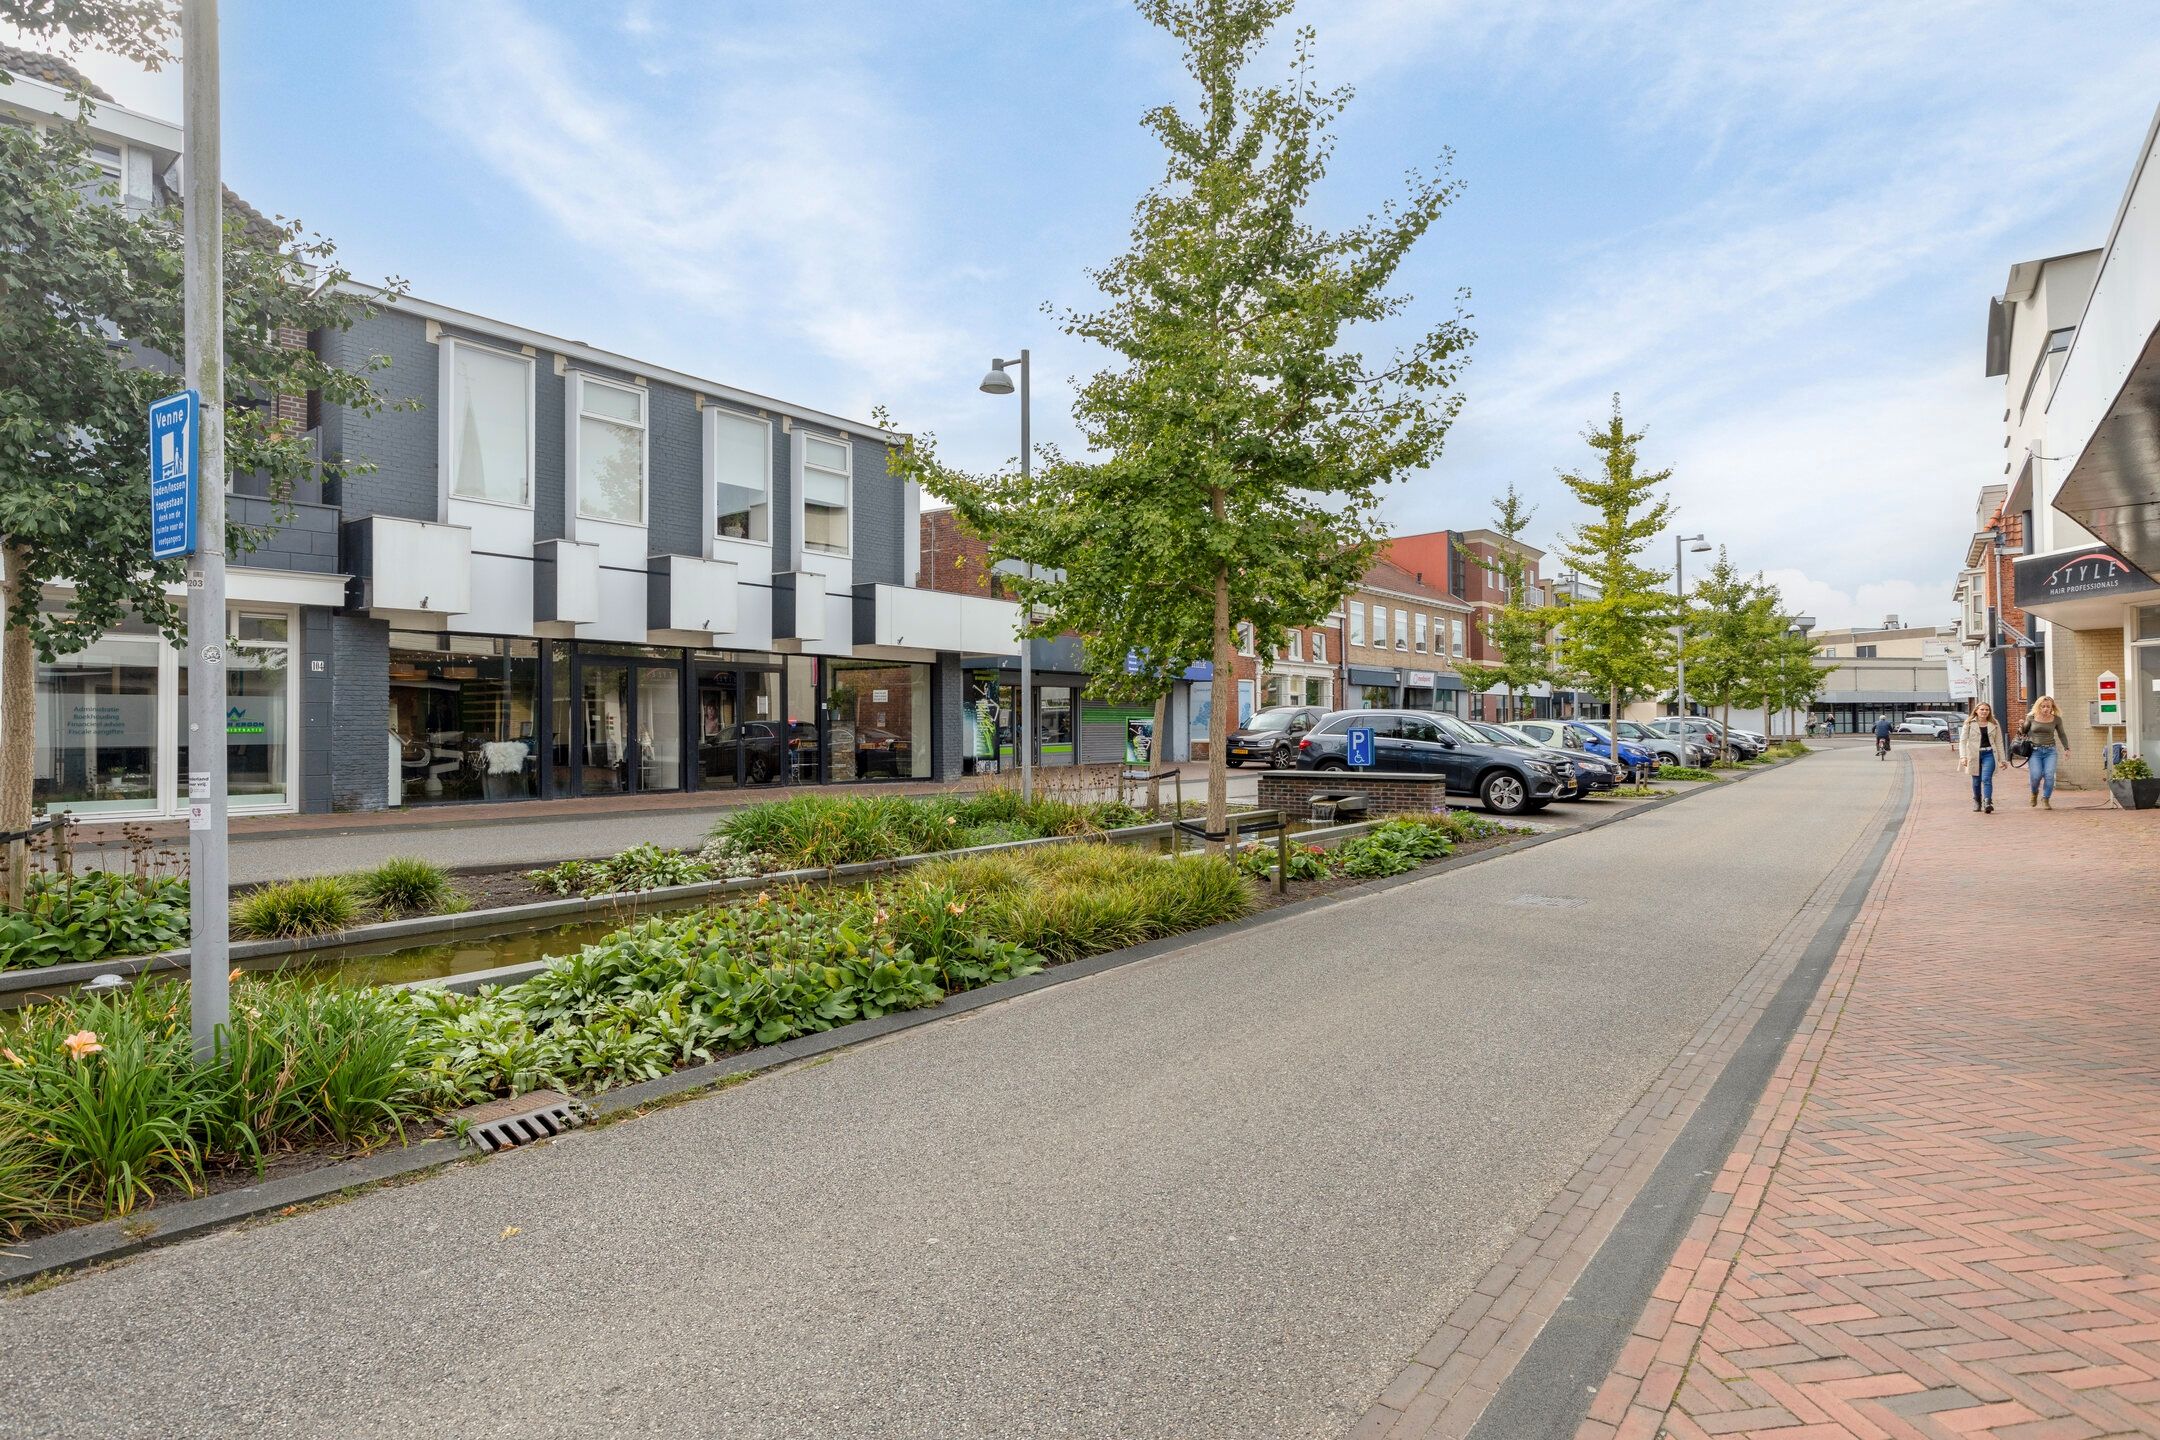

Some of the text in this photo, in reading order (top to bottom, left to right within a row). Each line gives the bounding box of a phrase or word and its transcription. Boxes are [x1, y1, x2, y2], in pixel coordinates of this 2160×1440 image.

[156, 409, 184, 429] Venne
[156, 496, 184, 511] toegestaan
[158, 513, 169, 523] denk
[175, 510, 181, 518] de
[156, 521, 184, 535] ruimte voor de
[158, 535, 182, 547] voetgangers
[2050, 561, 2117, 586] STYLE
[188, 579, 204, 588] 203
[2050, 580, 2119, 596] HAIR PROFESSIONALS
[1352, 731, 1365, 750] P
